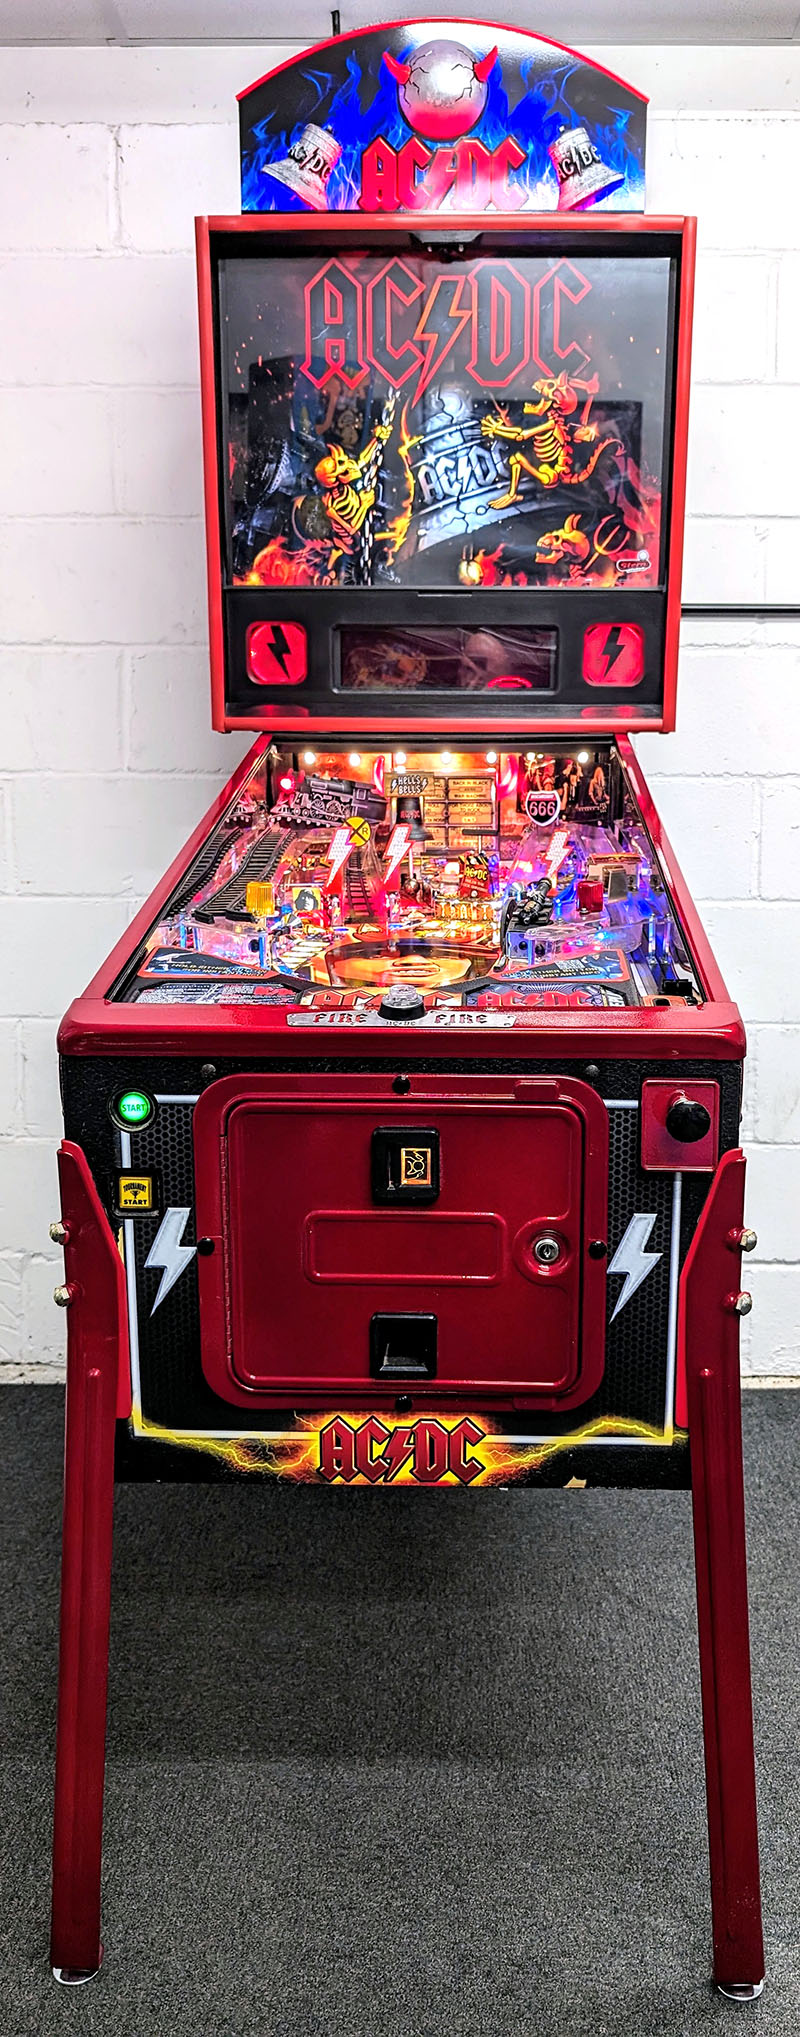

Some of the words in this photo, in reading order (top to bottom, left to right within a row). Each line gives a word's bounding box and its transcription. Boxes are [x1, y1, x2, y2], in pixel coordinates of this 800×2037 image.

[529, 801, 556, 816] 666
[362, 827, 369, 835] R
[313, 1013, 368, 1023] FIRE
[434, 1013, 489, 1024] FIRE
[122, 1103, 146, 1112] START
